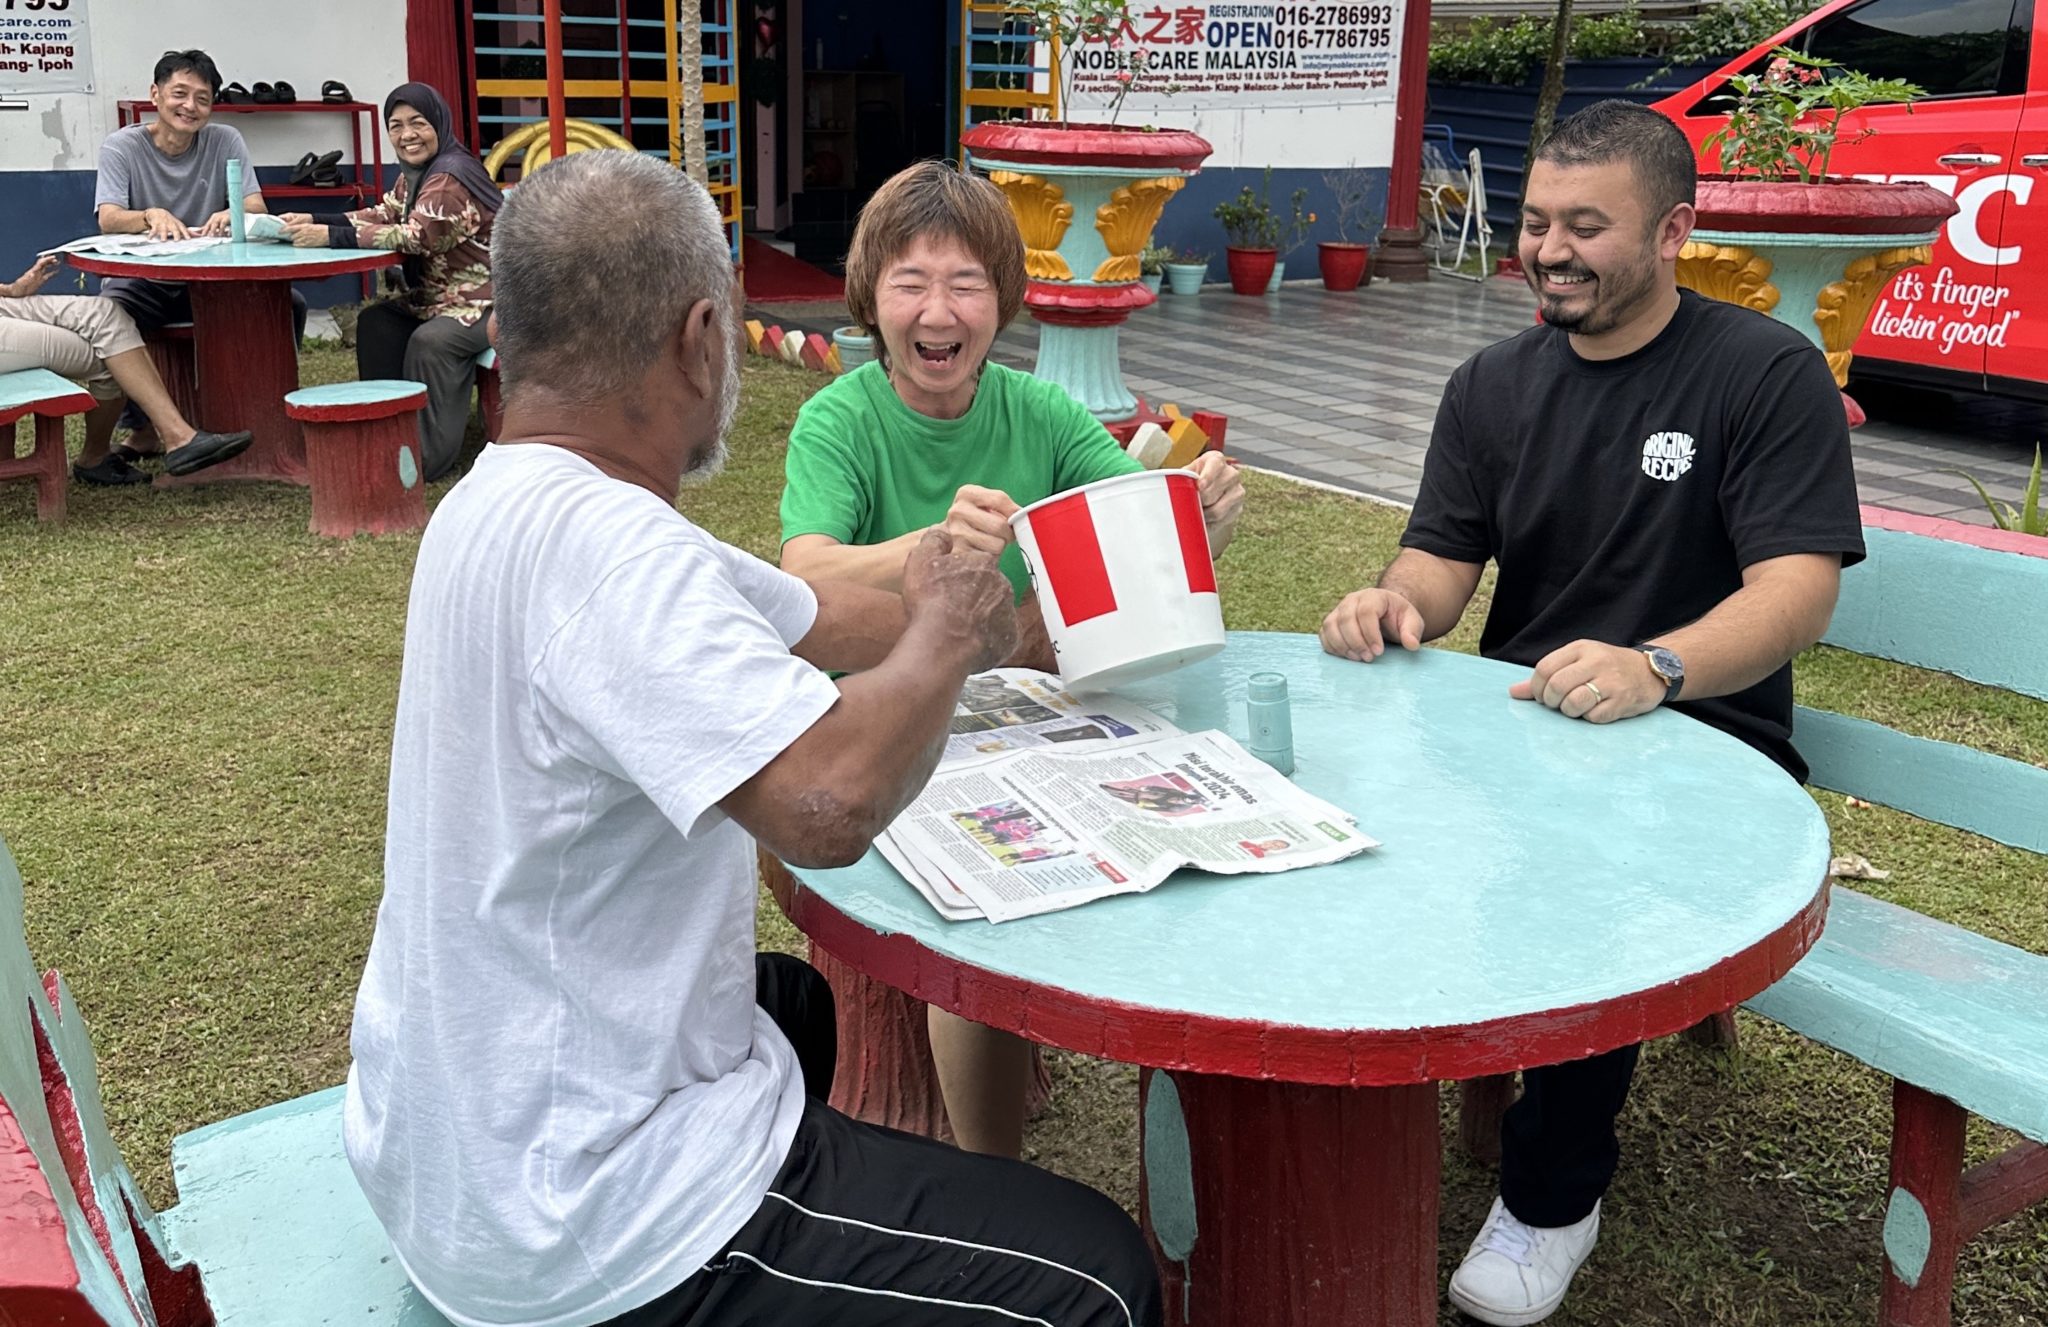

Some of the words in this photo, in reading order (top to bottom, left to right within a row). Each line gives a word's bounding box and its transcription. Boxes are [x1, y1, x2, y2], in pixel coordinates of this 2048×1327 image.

[1209, 5, 1275, 17] REGISTRATION
[1275, 6, 1392, 26] 016-2786993
[1207, 21, 1272, 48] OPEN
[1274, 28, 1390, 49] 016-7786795
[0, 43, 16, 54] h-
[20, 43, 74, 57] Kajang
[38, 58, 73, 73] Ipoh
[1148, 51, 1199, 69] CARE
[1205, 51, 1297, 69] MALAYSIA
[1074, 73, 1098, 82] Kuala
[1174, 72, 1204, 83] Subang
[1205, 72, 1225, 83] Jaya
[1226, 72, 1242, 81] USJ
[1263, 71, 1280, 80] USJ
[1363, 69, 1389, 79] Kajang
[1073, 84, 1086, 93] PJ
[1893, 272, 1924, 301] it's
[1931, 266, 2010, 318] finger
[1871, 299, 1943, 341] lickin'
[1202, 781, 1231, 800] 2024
[1229, 784, 1258, 805] emas
